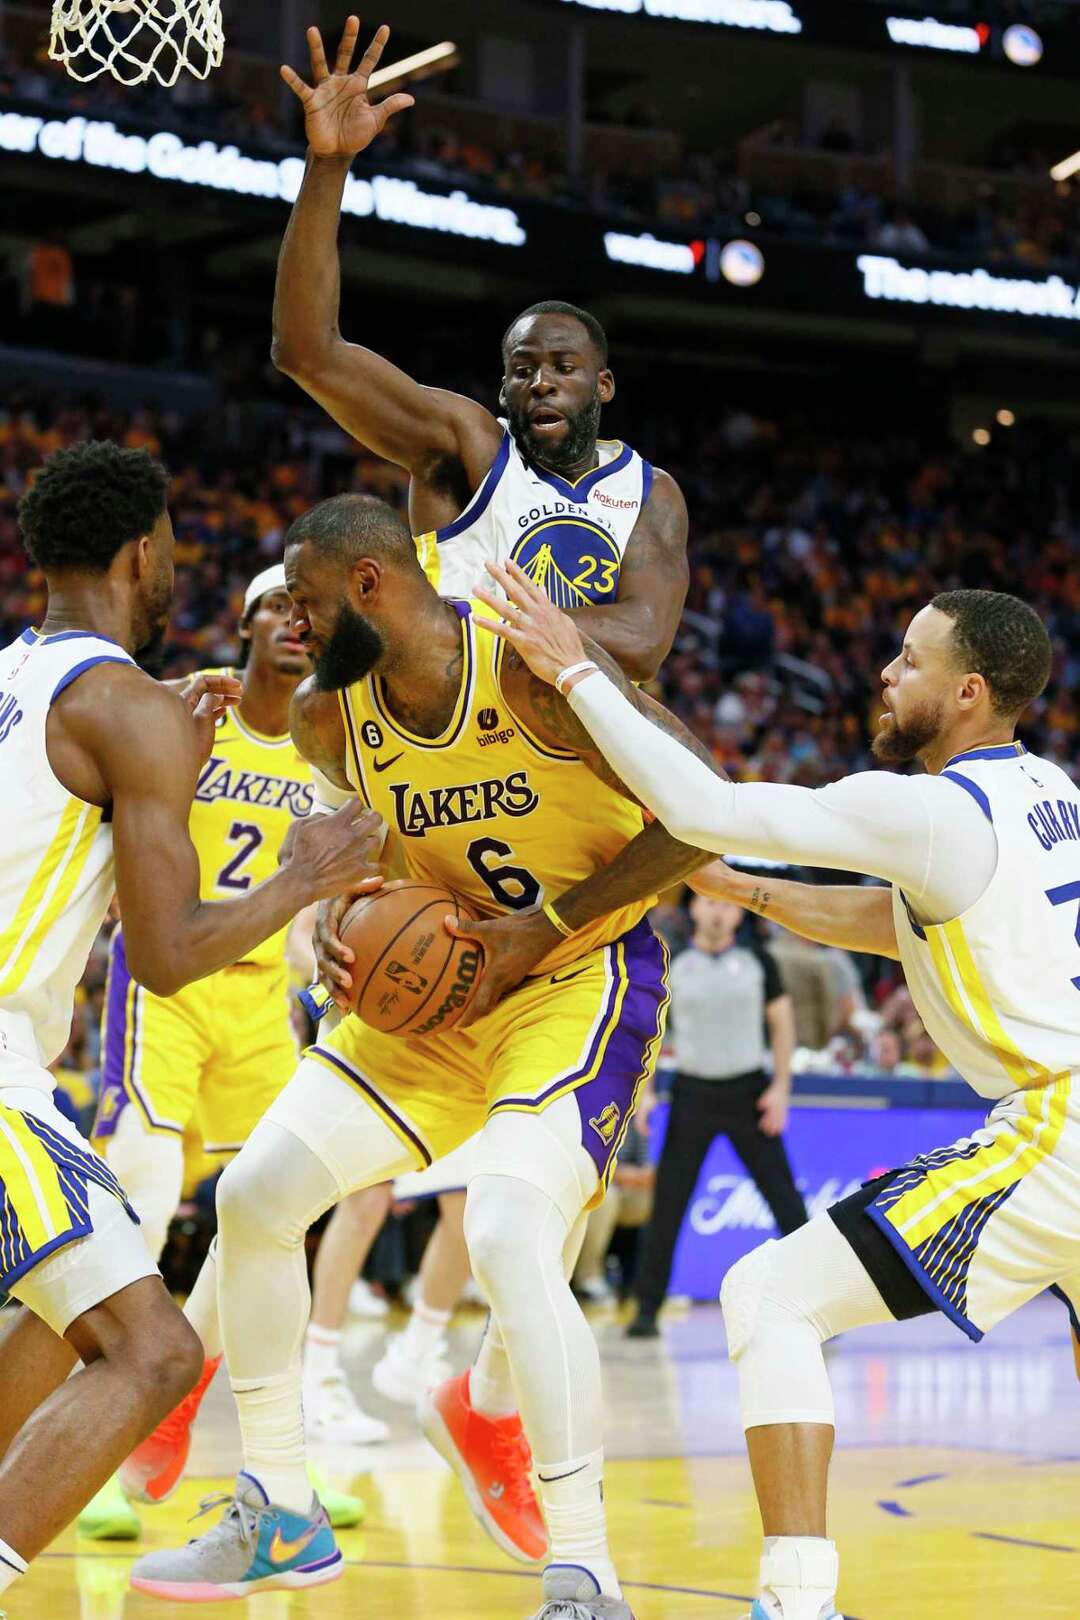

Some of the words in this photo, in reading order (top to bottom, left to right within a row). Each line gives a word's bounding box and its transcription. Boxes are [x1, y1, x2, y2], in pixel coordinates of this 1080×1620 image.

[592, 489, 639, 510] Rakuten
[573, 555, 619, 593] 23
[365, 724, 380, 745] 6
[476, 728, 515, 747] bibigo
[194, 757, 315, 817] LAKERS
[388, 771, 540, 838] LAKERS
[217, 822, 263, 889] 2
[466, 836, 542, 911] 6
